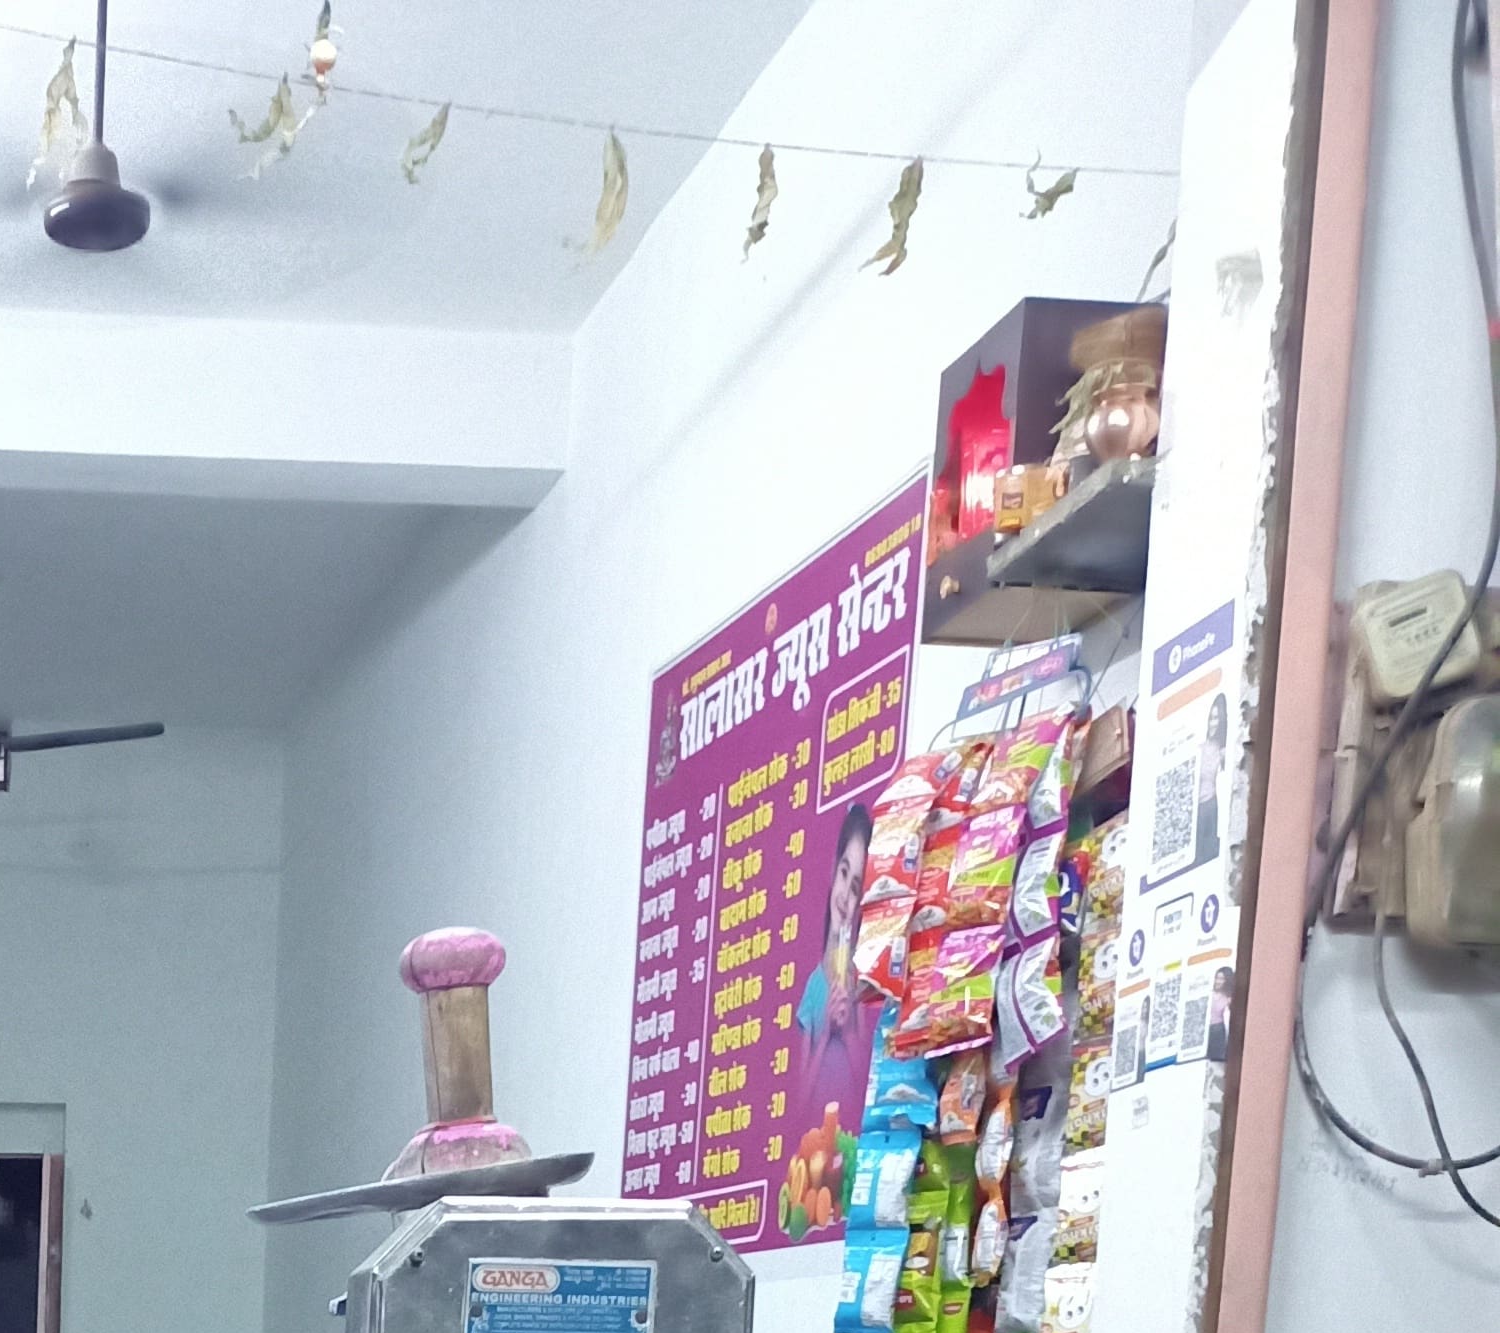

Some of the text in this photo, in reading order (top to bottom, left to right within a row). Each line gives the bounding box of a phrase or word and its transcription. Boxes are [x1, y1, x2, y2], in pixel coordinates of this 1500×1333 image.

[679, 647, 768, 759] सालासर
[482, 1270, 549, 1289] GANGA
[471, 1291, 647, 1306] ENGINEERING INDUSTRIES
